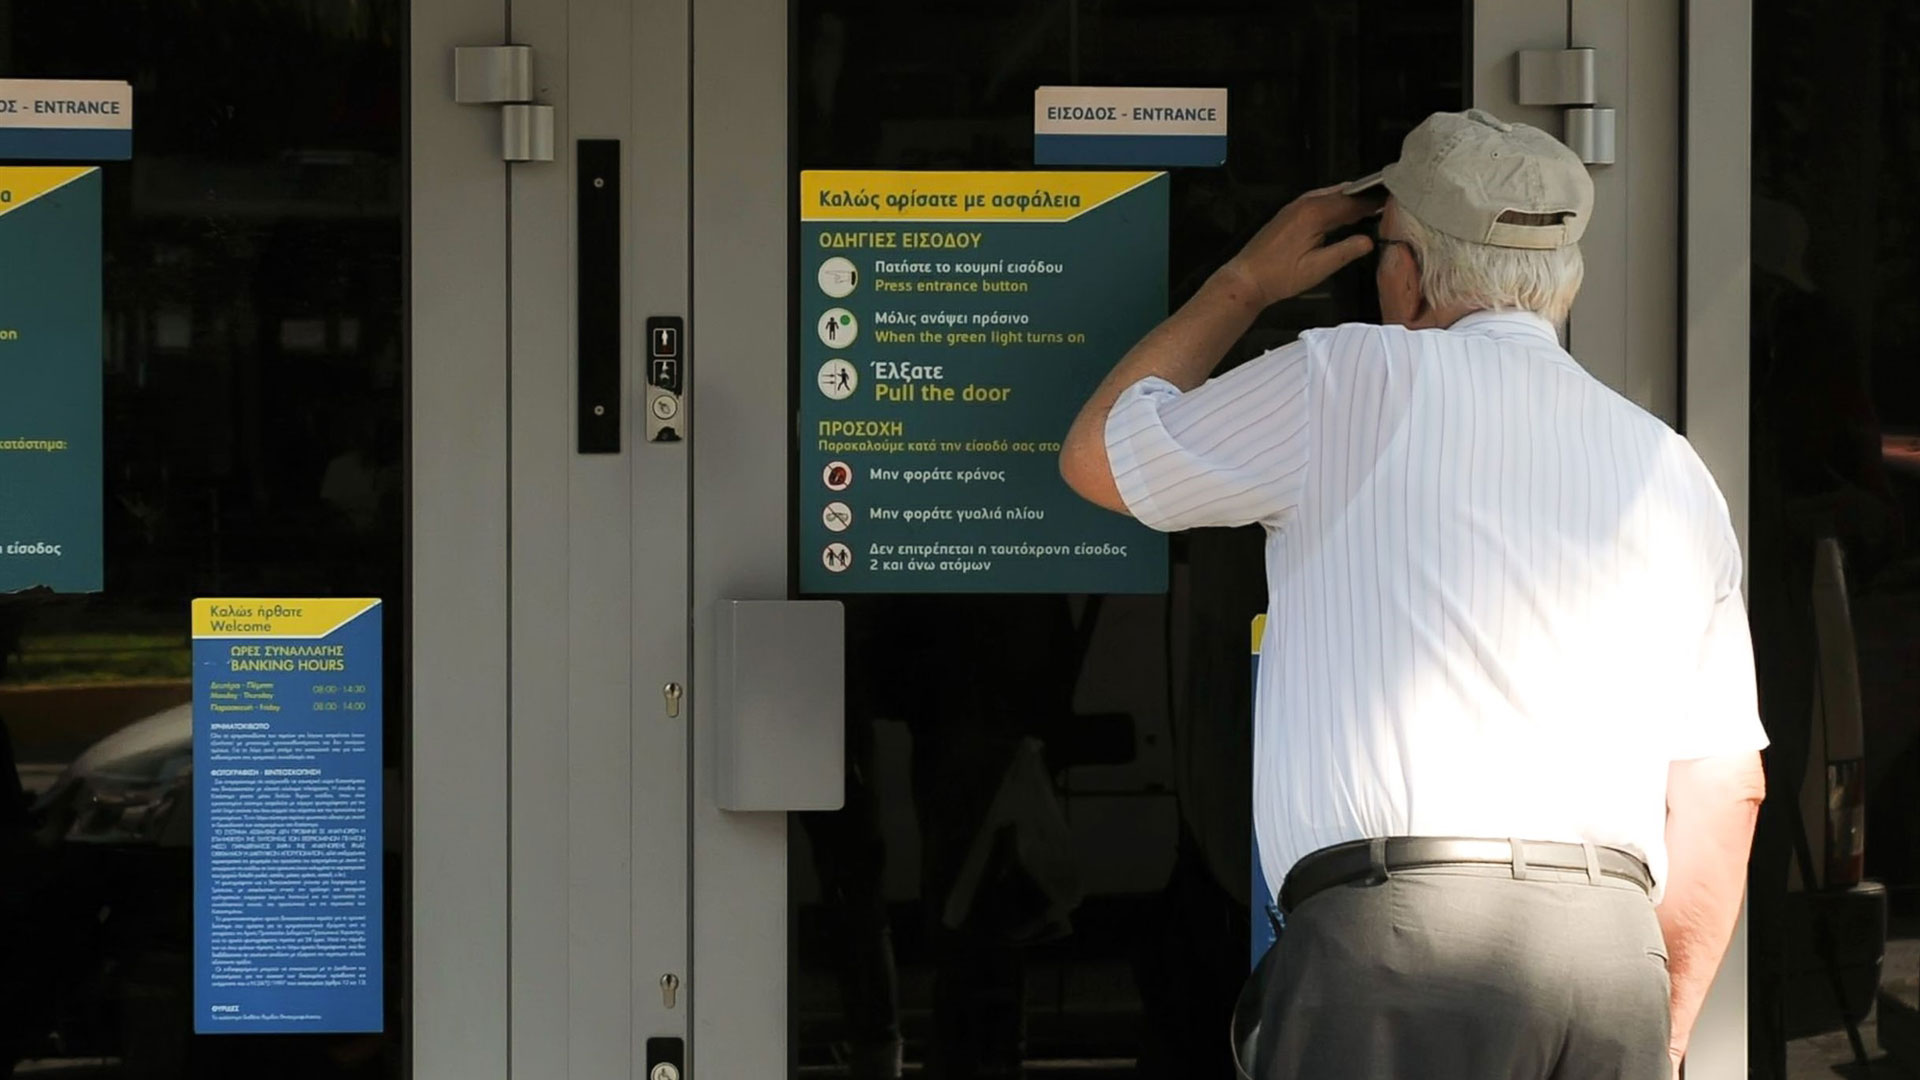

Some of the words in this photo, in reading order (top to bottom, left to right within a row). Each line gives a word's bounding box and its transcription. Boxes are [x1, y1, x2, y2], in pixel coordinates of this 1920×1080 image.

[35, 101, 119, 114] ENTRANCE
[1048, 107, 1116, 120] ΕΙΣΟΔΟΣ
[1133, 108, 1216, 121] ENTRANCE
[820, 189, 880, 210] Καλώς
[886, 190, 957, 211] ορίσατε
[965, 195, 985, 211] με
[992, 190, 1080, 211] ασφάλεια
[820, 233, 896, 247] ΟΔΗΓΙΕΣ
[903, 233, 981, 248] ΕΙΣΟΔΟΥ
[876, 260, 931, 272] Πατήστε
[936, 264, 950, 272] το
[955, 260, 1003, 276] κουμπί
[1008, 260, 1062, 273] εισόδου
[876, 279, 912, 291] Press
[917, 281, 977, 291] entrance
[983, 280, 1027, 291] button
[875, 311, 916, 325] Μόλις
[921, 311, 967, 327] ανάψει
[973, 311, 1028, 327] πράσινο
[875, 331, 915, 342] When
[920, 331, 942, 342] the
[947, 334, 986, 346] green
[992, 331, 1022, 346] light
[1027, 333, 1062, 342] turns
[870, 361, 943, 382] Έλξατε
[876, 384, 914, 401] Pull
[921, 384, 954, 401] the
[963, 384, 1010, 401] door
[820, 421, 902, 436] ΠΡΟΣΟΧΗ
[819, 439, 904, 453] Παρακαλούμε
[908, 439, 936, 451] κατά
[941, 443, 961, 451] την
[966, 440, 1007, 451] είσοδό
[1013, 441, 1034, 452] σας
[1039, 441, 1060, 451] στο
[870, 468, 899, 479] Μην
[903, 467, 952, 483] φοράτε
[957, 468, 1005, 483] κράνος
[870, 508, 899, 519] Μην
[903, 507, 952, 522] φοράτε
[957, 507, 1001, 522] γυαλιά
[1007, 507, 1043, 519] ηλίου
[7, 541, 61, 556] είσοδος
[870, 543, 894, 554] Δεν
[898, 542, 973, 557] επιτρέπεται
[978, 546, 986, 554] η
[991, 542, 1069, 557] ταυτόχρονη
[1075, 543, 1126, 556] είσοδος
[870, 559, 878, 570] 2
[883, 562, 903, 570] και
[908, 558, 935, 570] άνω
[940, 558, 991, 573] ατόμων
[210, 605, 252, 618] Καλώς
[257, 605, 302, 618] ήρθατε
[210, 621, 271, 632] Welcome
[231, 646, 261, 656] ΩΡΕΣ
[264, 646, 344, 656] ΣΥΝΑΛΛΑΓΗΣ
[231, 660, 294, 671] BANKING
[299, 660, 344, 671] HOURS
